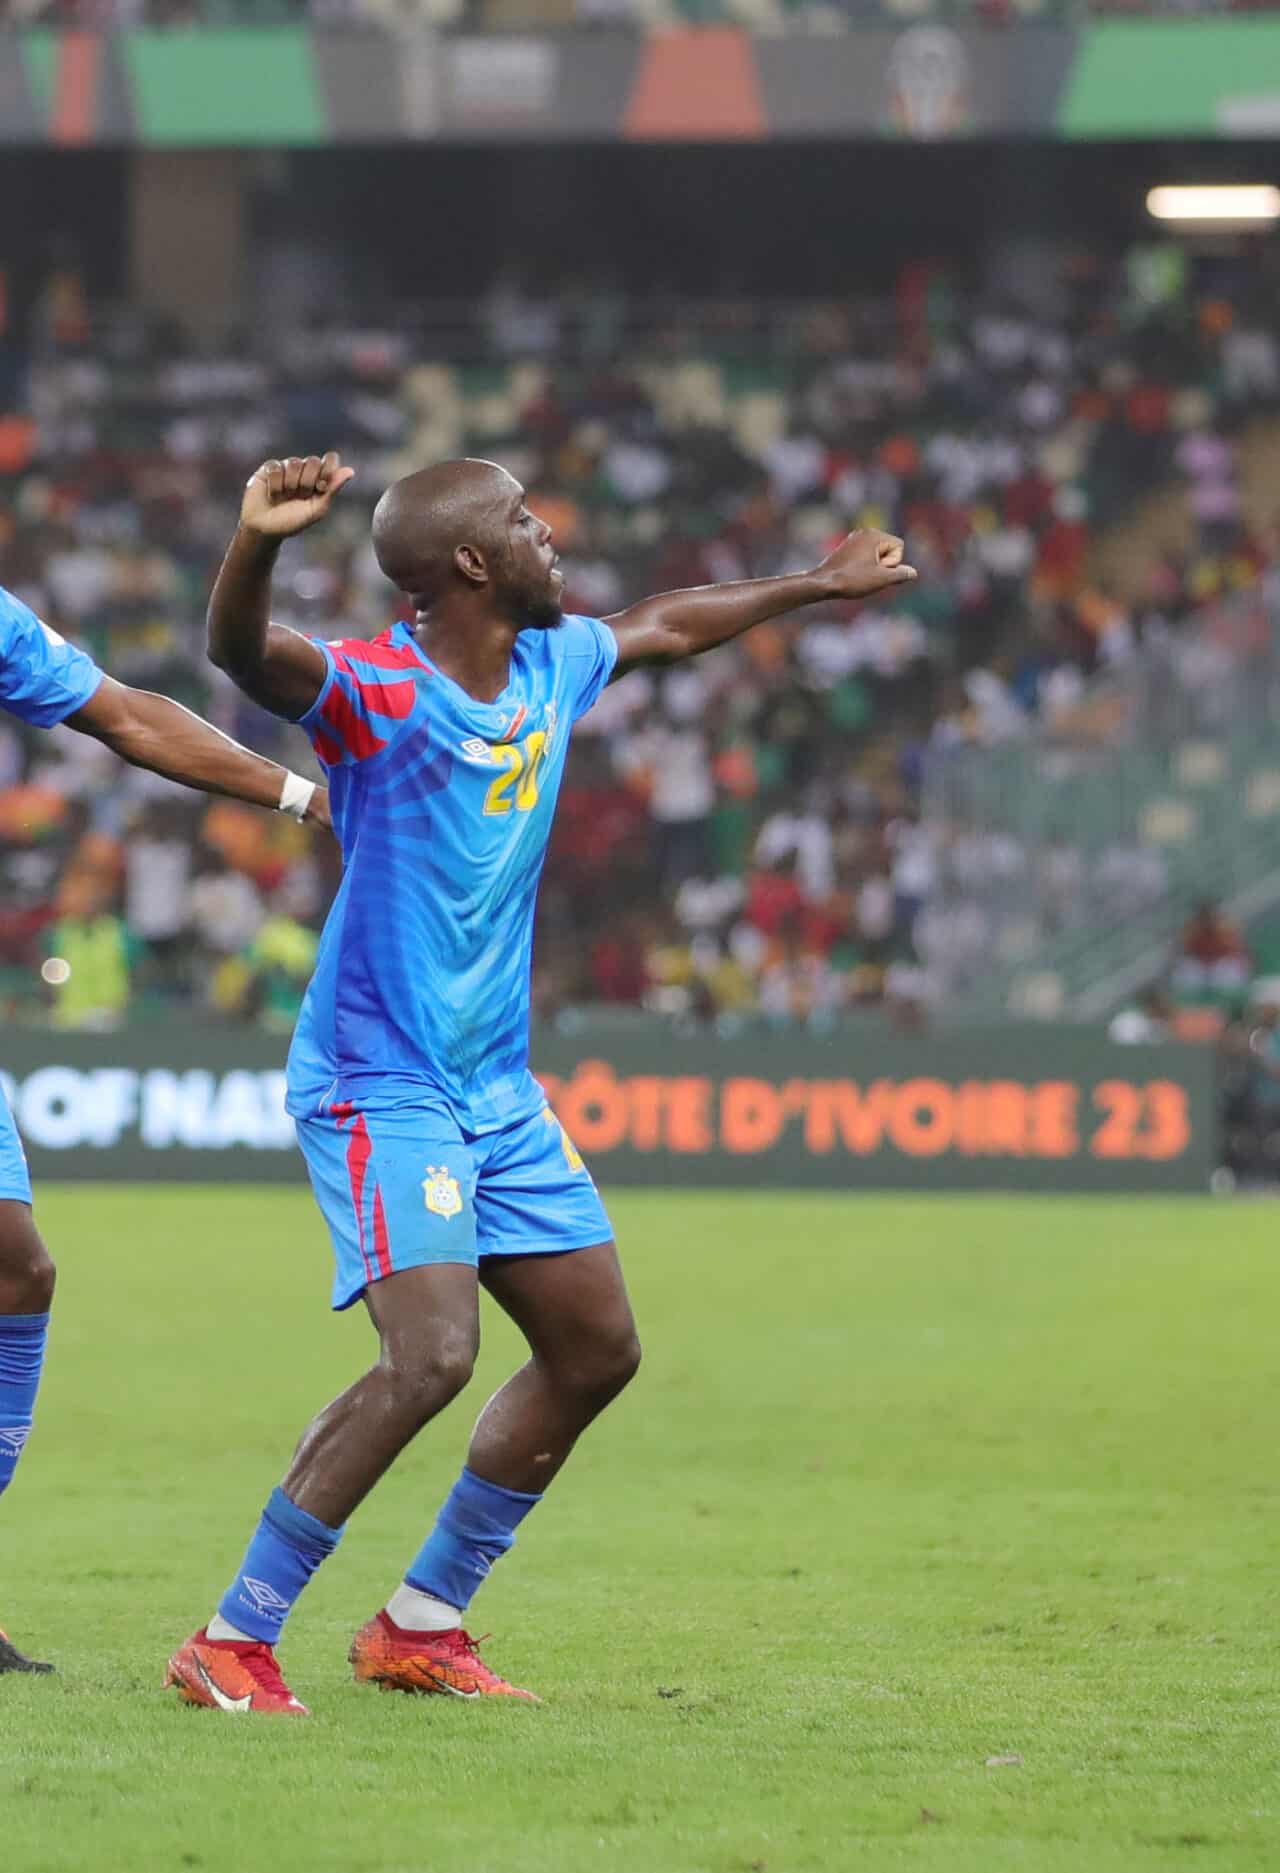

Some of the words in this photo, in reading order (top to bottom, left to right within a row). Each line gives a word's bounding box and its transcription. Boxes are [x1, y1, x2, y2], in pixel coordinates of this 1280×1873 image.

[483, 731, 546, 816] 20
[19, 1065, 138, 1149] OF
[534, 1058, 713, 1153] ÔTE
[1091, 1078, 1192, 1161] 23
